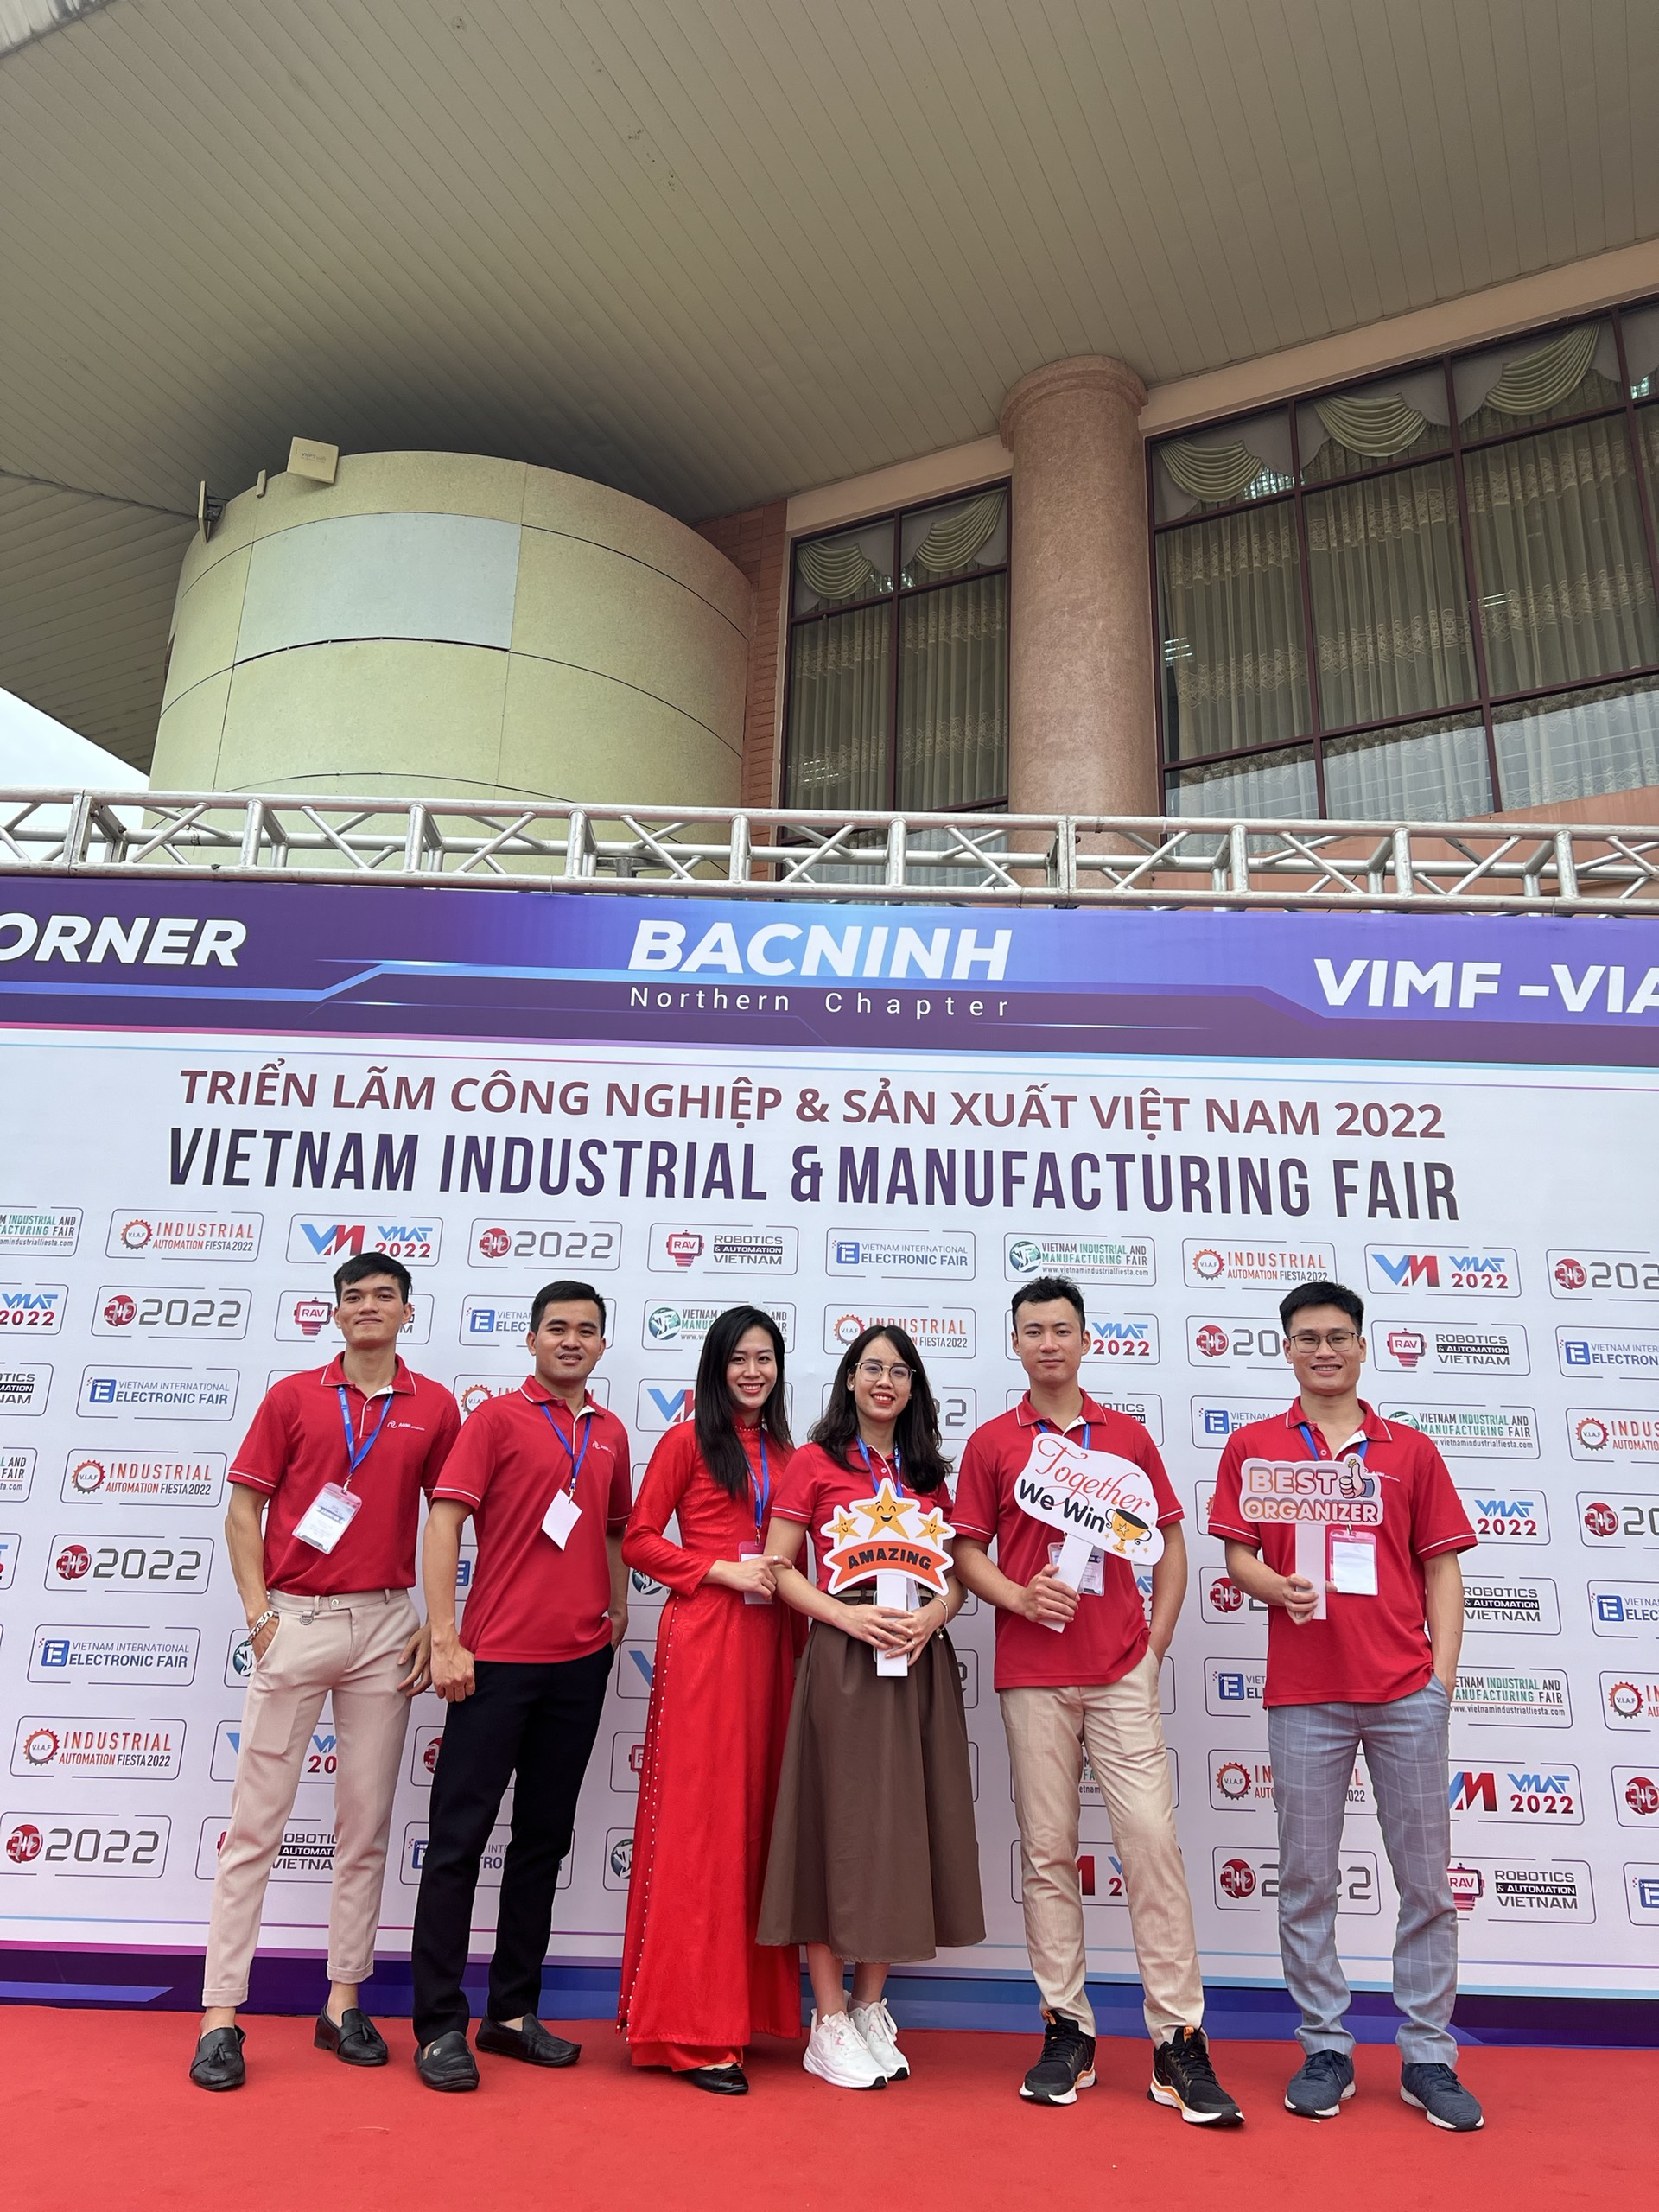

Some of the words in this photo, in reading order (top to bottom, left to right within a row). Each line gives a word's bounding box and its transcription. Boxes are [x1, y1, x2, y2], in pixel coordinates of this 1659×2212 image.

[0, 912, 247, 967] ORNER
[628, 919, 1013, 981] BACNINH
[1314, 958, 1502, 1008] VIMF
[631, 987, 791, 1012] Northern
[824, 992, 1008, 1020] Chapter
[179, 1058, 322, 1107] TRIỂN
[332, 1068, 435, 1112] LÃM
[450, 1071, 588, 1117] CÔNG
[606, 1076, 781, 1130] NGHIỆP
[796, 1088, 829, 1122] &
[843, 1079, 935, 1125] SẢN
[950, 1083, 1077, 1128] XUẤT
[1090, 1088, 1189, 1140] VIỆT
[1208, 1098, 1319, 1135] NAM
[1335, 1102, 1445, 1139] 2022
[169, 1128, 418, 1190] VIETNAM
[440, 1136, 768, 1200] INDUSTRIAL
[791, 1144, 823, 1203] &
[838, 1147, 1310, 1216] MANUFACTURING
[1334, 1160, 1459, 1221] FAIR
[8, 1214, 56, 1225] INDUSTRIAL
[59, 1216, 77, 1225] AND
[53, 1226, 74, 1236] FAIR
[156, 1222, 254, 1238] INDUSTRIAL
[153, 1239, 203, 1249] AUTOMATION
[514, 1231, 612, 1259] 2022
[674, 1240, 696, 1249] RAV
[715, 1235, 782, 1244] ROBOTICS
[375, 1243, 431, 1258] 2022
[901, 1245, 967, 1254] INTERNATIONAL
[1042, 1243, 1077, 1253] VIETNAM
[1079, 1243, 1127, 1255] INDUSTRIAL
[1130, 1245, 1147, 1255] AND
[714, 1255, 782, 1265] VIETNAM
[861, 1254, 937, 1265] ELECTRONIC
[940, 1256, 967, 1266] FAIR
[1042, 1253, 1122, 1265] MANUFACTURING
[1126, 1255, 1147, 1266] FAIR
[1228, 1251, 1326, 1268] INDUSTRIAL
[1227, 1269, 1277, 1280] AUTOMATION
[1452, 1274, 1508, 1289] 2022
[0, 1309, 54, 1326] 2022
[139, 1299, 242, 1327] 2022
[302, 1309, 325, 1318] RAV
[683, 1308, 717, 1319] VIETNAM
[771, 1311, 787, 1321] AND
[1232, 1329, 1280, 1356] 20
[1436, 1334, 1508, 1344] ROBOTICS
[1093, 1339, 1149, 1356] 2022
[1446, 1345, 1508, 1354] AUTOMATION
[1591, 1343, 1630, 1352] VIETNAM
[1439, 1355, 1510, 1365] VIETNAM
[119, 1382, 158, 1390] VIETNAM
[160, 1382, 229, 1392] INTERNATIONAL
[116, 1392, 195, 1403] ELECTRONIC
[199, 1394, 228, 1405] FAIR
[1097, 1402, 1145, 1413] OTICS
[1420, 1414, 1457, 1424] VIETNAM
[1459, 1414, 1509, 1425] INDUSTRIAL
[1512, 1416, 1529, 1426] AND
[1421, 1425, 1503, 1436] MANUFACTURING
[1508, 1427, 1530, 1438] FAIR
[8, 1457, 27, 1467] AND
[1, 1468, 25, 1479] FAIR
[110, 1463, 213, 1480] INDUSTRIAL
[1035, 1438, 1151, 1513] Together
[1249, 1466, 1338, 1495] BEST
[105, 1483, 158, 1493] AUTOMATION
[1019, 1479, 1055, 1511] We
[1063, 1501, 1106, 1534] Win
[1244, 1498, 1378, 1523] ORGANIZER
[1478, 1519, 1537, 1535] 2022
[93, 1548, 201, 1580] 2022
[848, 1548, 931, 1570] AMAZING
[1463, 1586, 1538, 1598] ROBOTICS
[1473, 1599, 1538, 1609] AUTOMATION
[1464, 1610, 1541, 1622] VIETNAM
[72, 1643, 115, 1651] VIETNAM
[117, 1644, 189, 1653] INTERNATIONAL
[69, 1654, 153, 1666] ELECTRONIC
[156, 1656, 188, 1668] FAIR
[1487, 1677, 1539, 1690] INDUSTRIAL
[1542, 1679, 1560, 1691] AND
[1452, 1688, 1534, 1703] ANUFACTURING
[1539, 1693, 1563, 1704] FAIR
[63, 1732, 171, 1751] INDUSTRIAL
[59, 1754, 115, 1765] AUTOMATION
[307, 1755, 337, 1774] 20
[1510, 1794, 1574, 1814] 2022
[45, 1828, 159, 1864] 2022
[1495, 1870, 1574, 1882] ROBOTICS
[1450, 1878, 1474, 1888] RAV
[1507, 1885, 1575, 1896] AUTOMATION
[1497, 1896, 1578, 1910] VIETNAM
